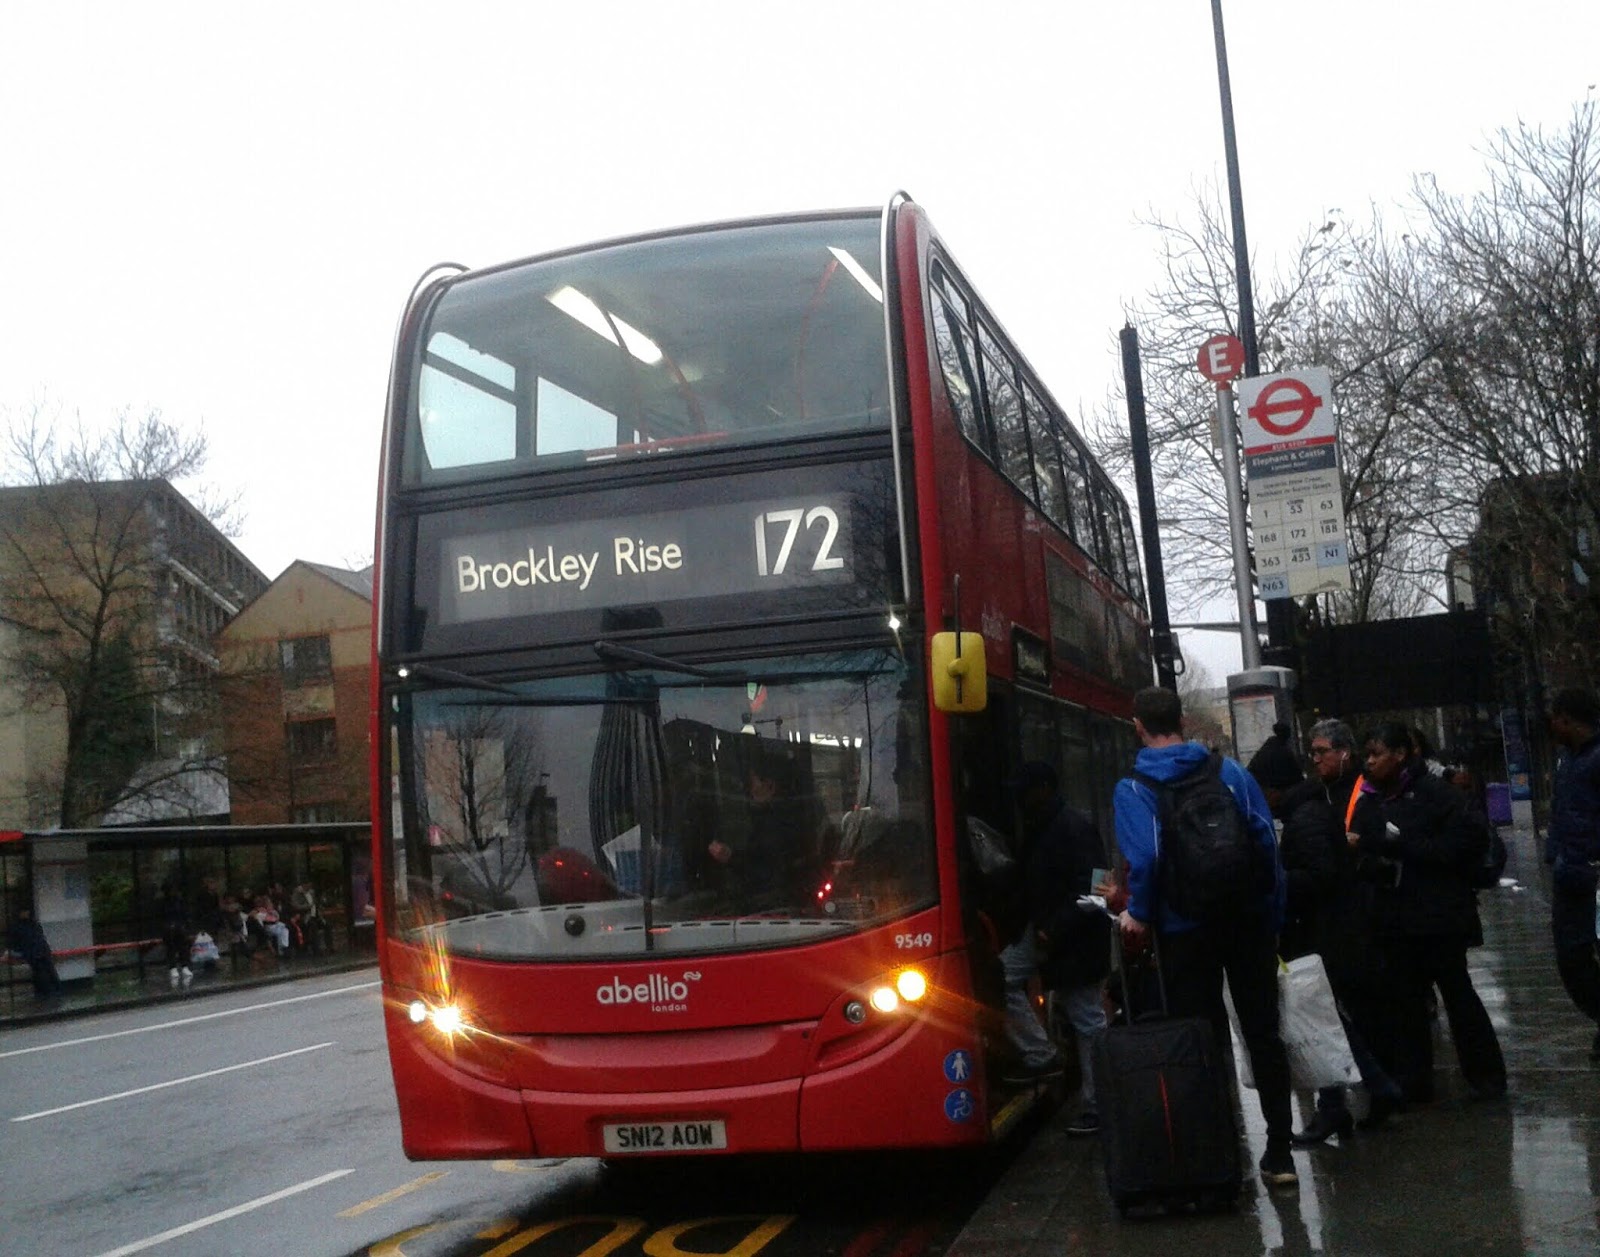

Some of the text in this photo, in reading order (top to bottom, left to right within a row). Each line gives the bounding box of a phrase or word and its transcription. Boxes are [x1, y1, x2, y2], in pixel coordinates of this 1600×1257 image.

[1208, 342, 1232, 375] E
[1289, 505, 1303, 515] 53
[1320, 500, 1334, 510] 63
[1290, 528, 1307, 539] 172
[1321, 524, 1338, 535] 188
[754, 505, 845, 577] 172
[1260, 532, 1278, 544] 168
[1291, 552, 1311, 563] 453
[1325, 548, 1339, 558] N1
[457, 536, 683, 593] Brockley Rise
[1261, 556, 1281, 568] 363
[1262, 580, 1285, 592] N63
[895, 933, 933, 949] 9549
[596, 973, 689, 1004] abellio
[652, 1003, 687, 1013] london
[617, 1124, 713, 1148] SN12 AOW
